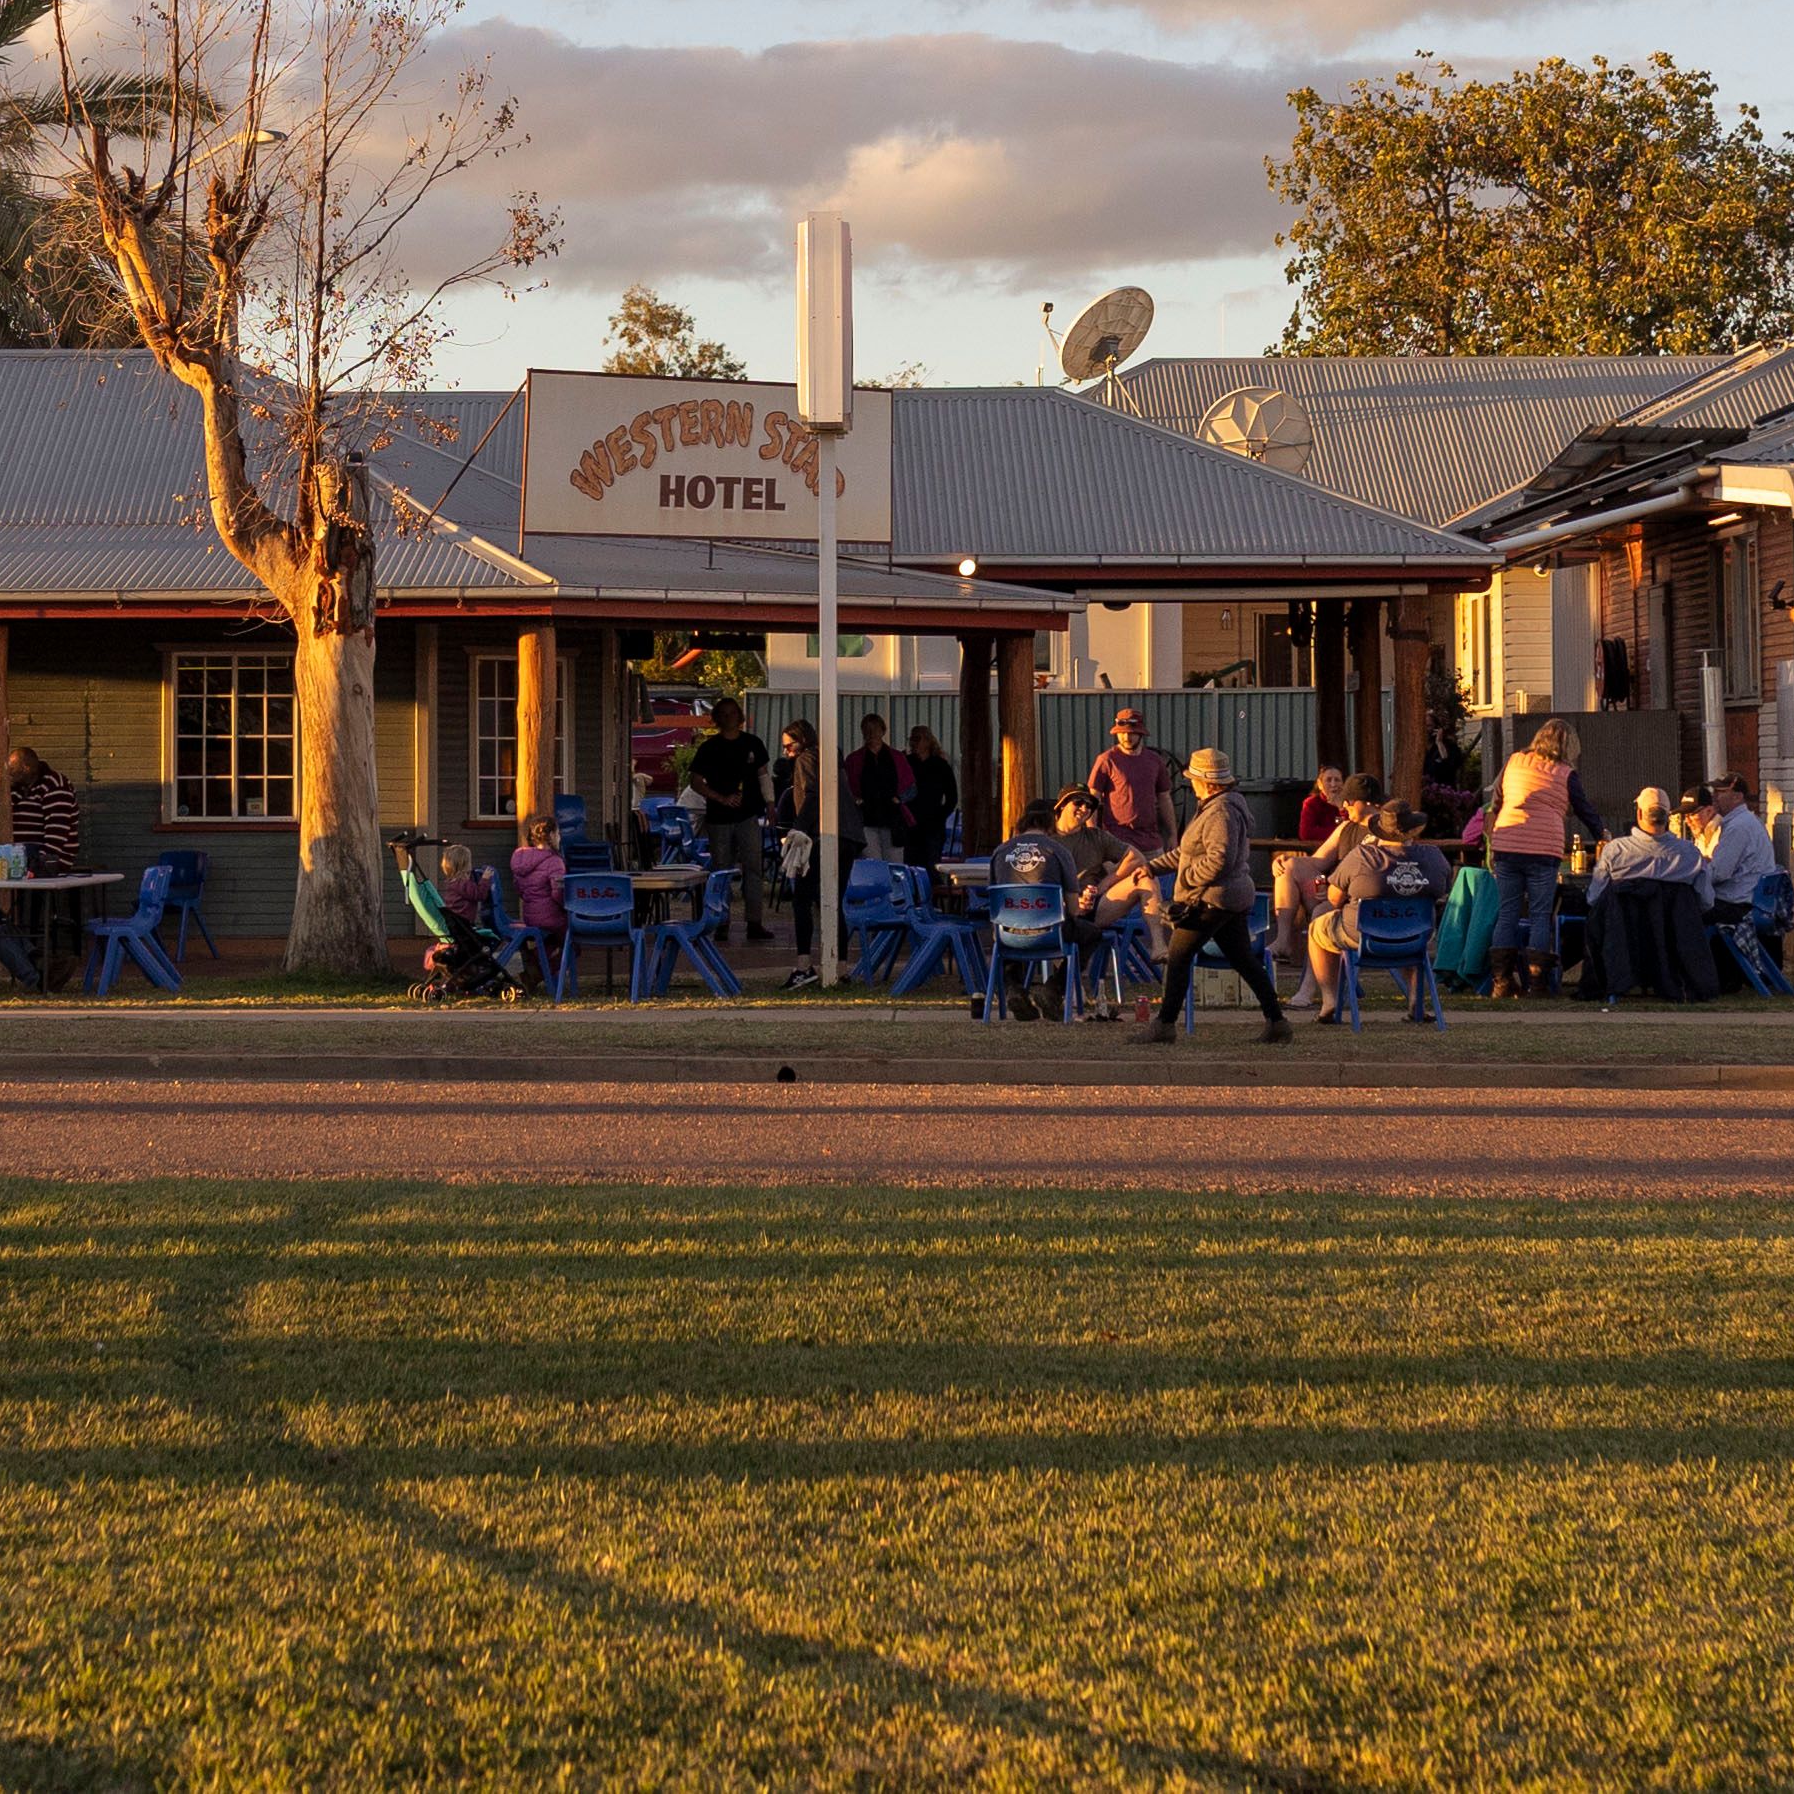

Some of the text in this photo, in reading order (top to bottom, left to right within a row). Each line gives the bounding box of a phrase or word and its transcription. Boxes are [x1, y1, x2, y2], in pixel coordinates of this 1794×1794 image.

[570, 399, 845, 501] WESTERN STA
[659, 474, 786, 511] HOTEL
